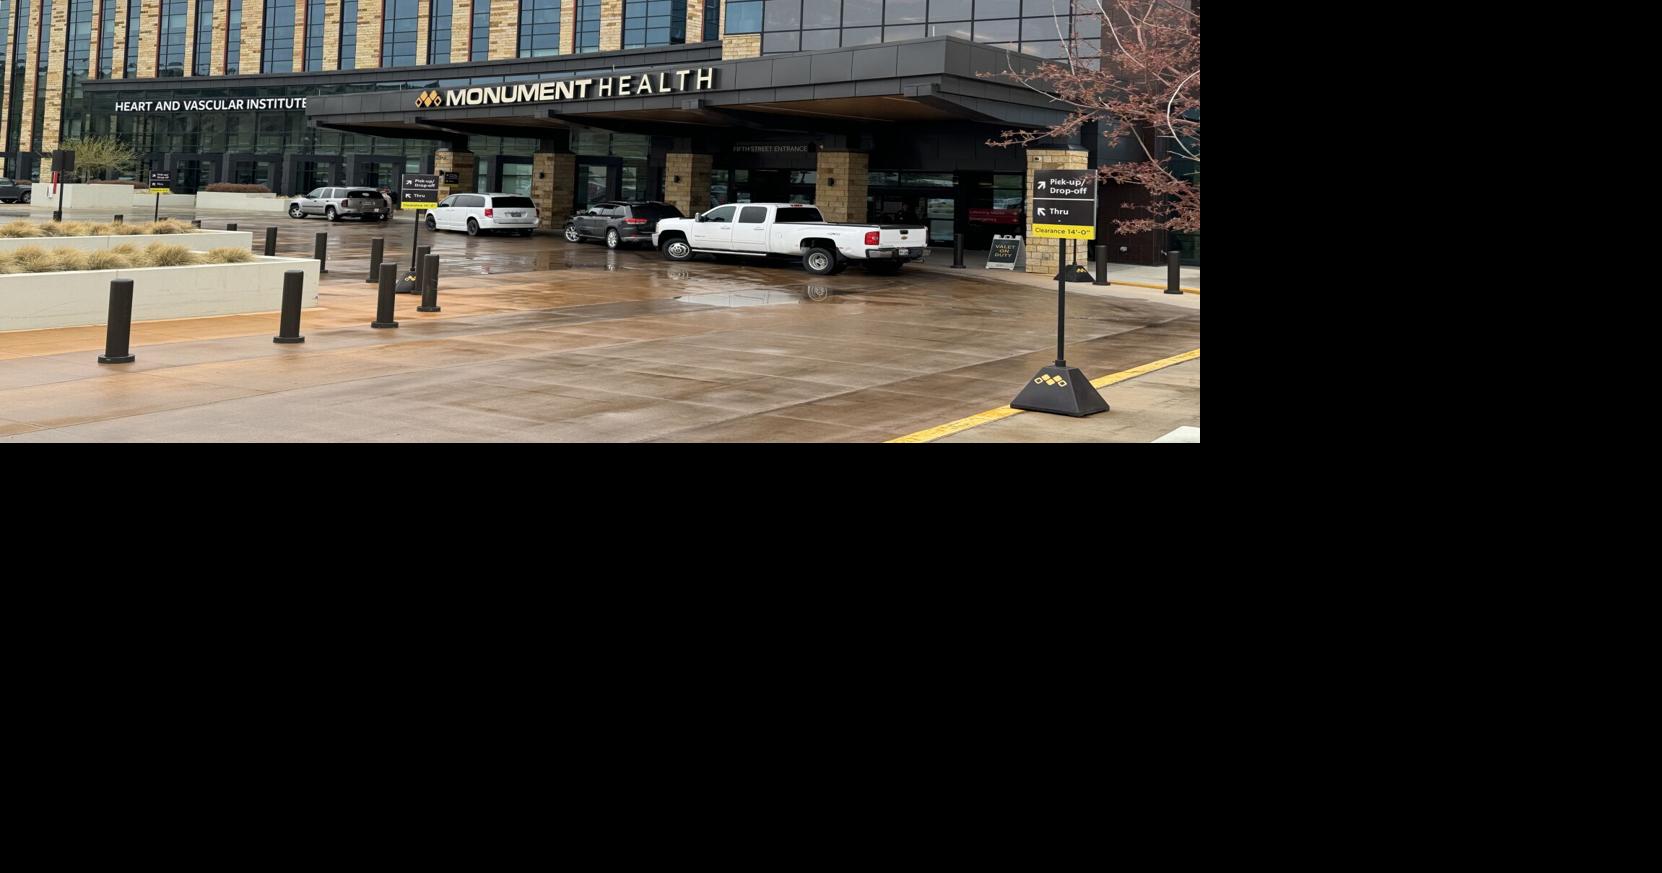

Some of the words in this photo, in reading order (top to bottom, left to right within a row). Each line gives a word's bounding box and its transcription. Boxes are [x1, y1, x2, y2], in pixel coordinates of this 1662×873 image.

[446, 79, 592, 106] MONUMENT
[599, 68, 713, 97] HEALTH
[115, 101, 153, 112] HEART
[155, 101, 181, 111] AND
[183, 99, 244, 111] VASCULAR
[1049, 178, 1087, 187] Pick-up/
[1049, 187, 1088, 195] Drop-off
[1049, 207, 1069, 215] Thru
